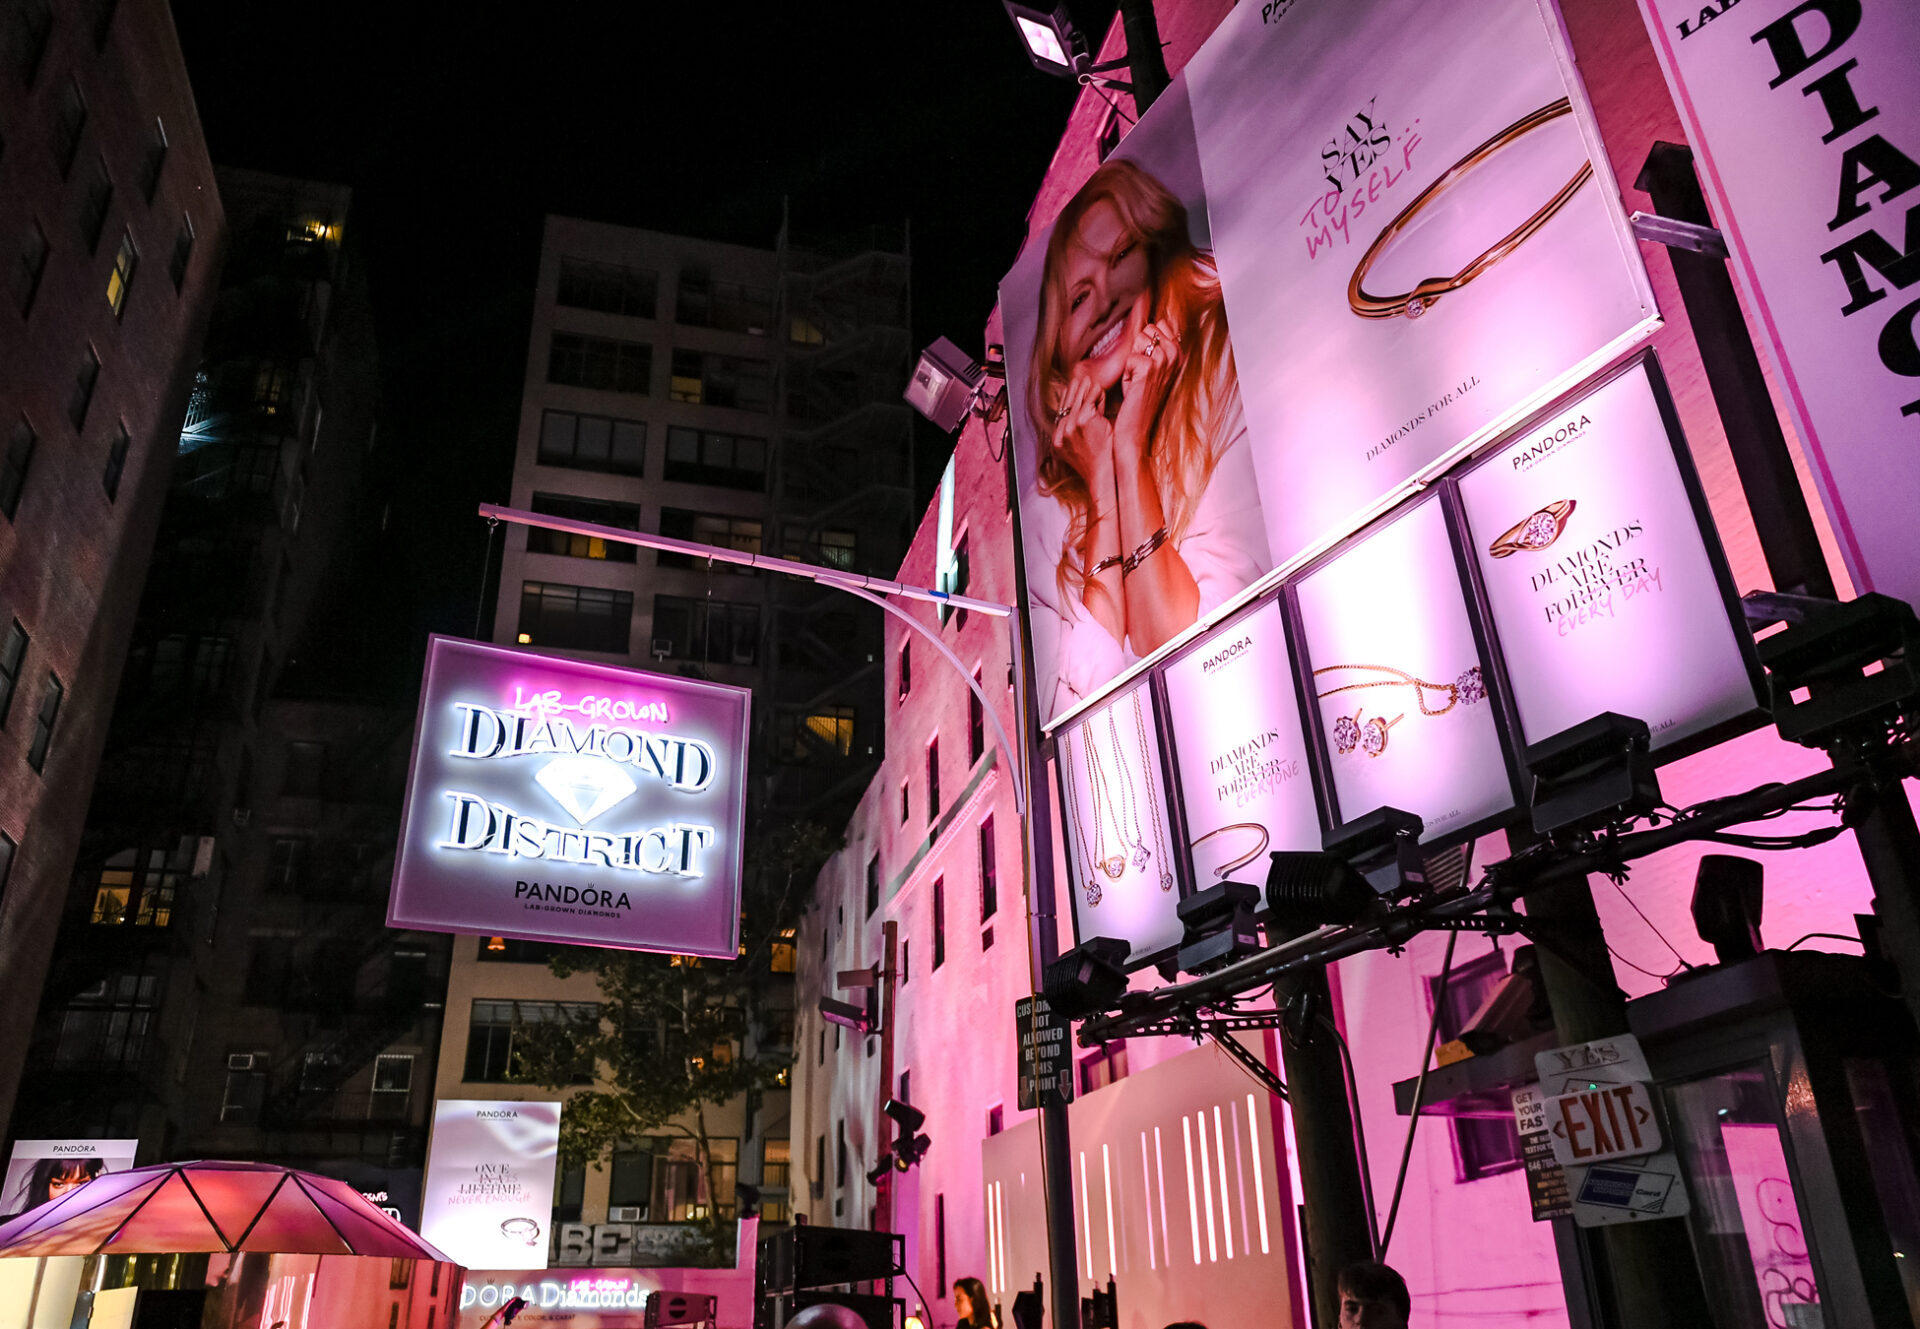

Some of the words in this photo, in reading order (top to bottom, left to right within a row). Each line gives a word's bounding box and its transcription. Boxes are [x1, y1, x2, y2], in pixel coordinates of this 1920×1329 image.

[1321, 96, 1377, 174] SAY
[1325, 122, 1391, 194] YES
[1300, 190, 1341, 228] TO
[1306, 134, 1422, 260] MYSELF
[1366, 412, 1426, 462] DIAMONDS
[1428, 394, 1453, 418] FOR
[1455, 375, 1480, 398] ALL
[1512, 415, 1592, 470] PANDORA
[1531, 519, 1643, 592] DIAMONDS
[1570, 552, 1613, 587] ARE
[1545, 558, 1648, 623] FOREVER
[1557, 593, 1615, 637] EVERY
[1622, 567, 1663, 601] DAY
[1203, 636, 1253, 673] PANDORA
[515, 687, 668, 721] LAB-GROWN
[449, 702, 717, 793] DIAMOND
[1210, 728, 1280, 775] DIAMONDS
[1234, 751, 1261, 776] ARE
[1236, 760, 1300, 808] EVERYONE
[438, 791, 714, 879] DISTRICT
[515, 881, 632, 911] PANDORA
[524, 903, 576, 915] LAB-GROWN
[578, 908, 621, 919] DIAMONDS
[1029, 1076, 1057, 1093] PINT
[1516, 1092, 1533, 1105] GET
[477, 1110, 518, 1118] PANDORA
[1519, 1102, 1543, 1116] YOUR
[1520, 1115, 1545, 1131] FAS
[1559, 1086, 1643, 1159] EXIT
[53, 1145, 96, 1153] PANDORA
[475, 1163, 510, 1175] ONCE
[1635, 1188, 1661, 1198] Card
[540, 1281, 650, 1308] Diamonds
